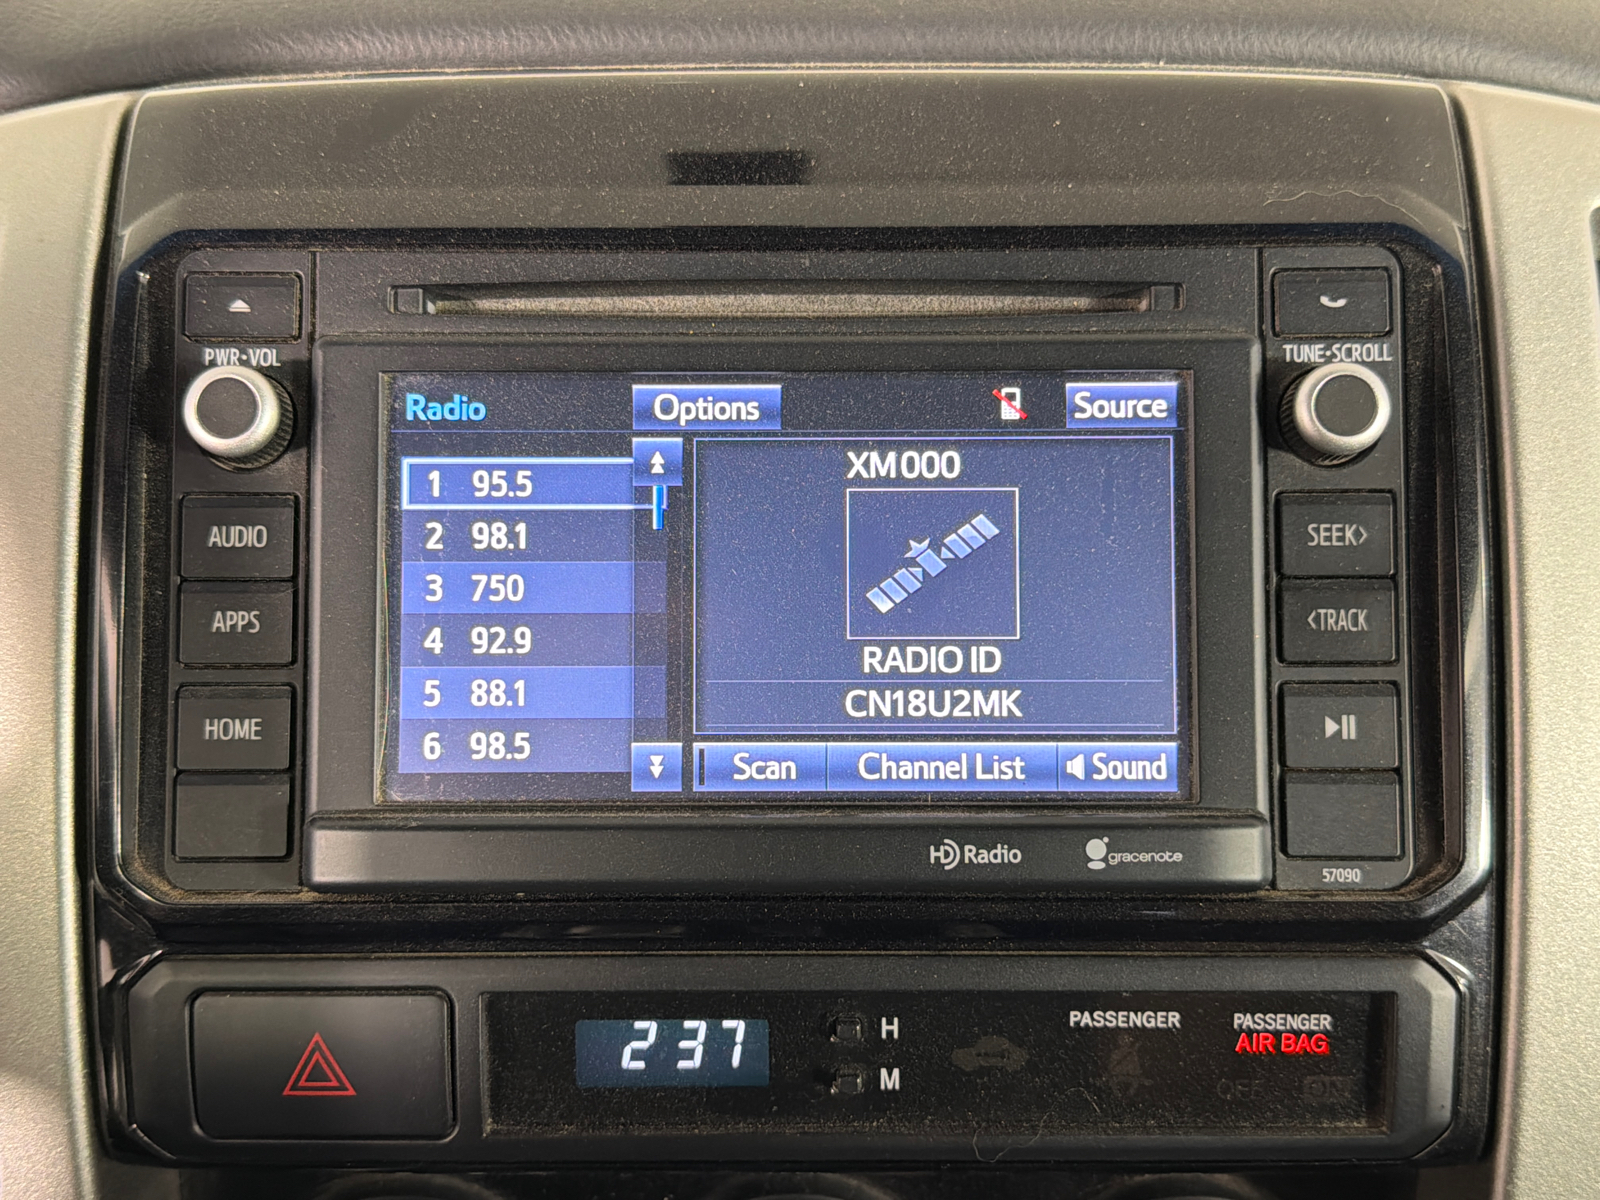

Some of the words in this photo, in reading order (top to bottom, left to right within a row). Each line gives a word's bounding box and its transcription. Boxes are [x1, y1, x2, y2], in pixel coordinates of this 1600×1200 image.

[405, 392, 487, 422] Radio
[653, 393, 760, 427] Options
[1074, 391, 1168, 419] Source
[428, 470, 440, 498] 1
[472, 469, 533, 498] 95.5
[208, 525, 268, 548] AUDIO
[425, 521, 444, 550] 2
[471, 521, 527, 550] 98.1
[425, 573, 443, 602] 3
[471, 573, 525, 602] 750
[212, 610, 260, 634] APPS
[423, 626, 444, 655] 4
[470, 626, 532, 654] 92.9
[863, 645, 964, 674] RADIO
[970, 645, 1002, 673] ID
[423, 679, 441, 707] 5
[470, 678, 525, 707] 88.1
[845, 689, 1023, 718] CN18U2MK
[204, 718, 262, 741] HOME
[423, 731, 442, 760] 6
[470, 731, 531, 760] 98.5
[733, 751, 797, 781] Scan
[858, 751, 968, 780] Channel
[975, 752, 1026, 780] List
[1092, 751, 1168, 781] Sound
[964, 843, 1022, 864] Radio
[1107, 850, 1184, 866] gracenote
[1322, 867, 1361, 883] 57090
[881, 1016, 899, 1039] H
[1069, 1010, 1181, 1028] PASSENGER
[1233, 1012, 1332, 1031] PASSENGER
[1234, 1032, 1276, 1055] AIR
[1280, 1032, 1330, 1055] BAG
[880, 1067, 900, 1090] M
